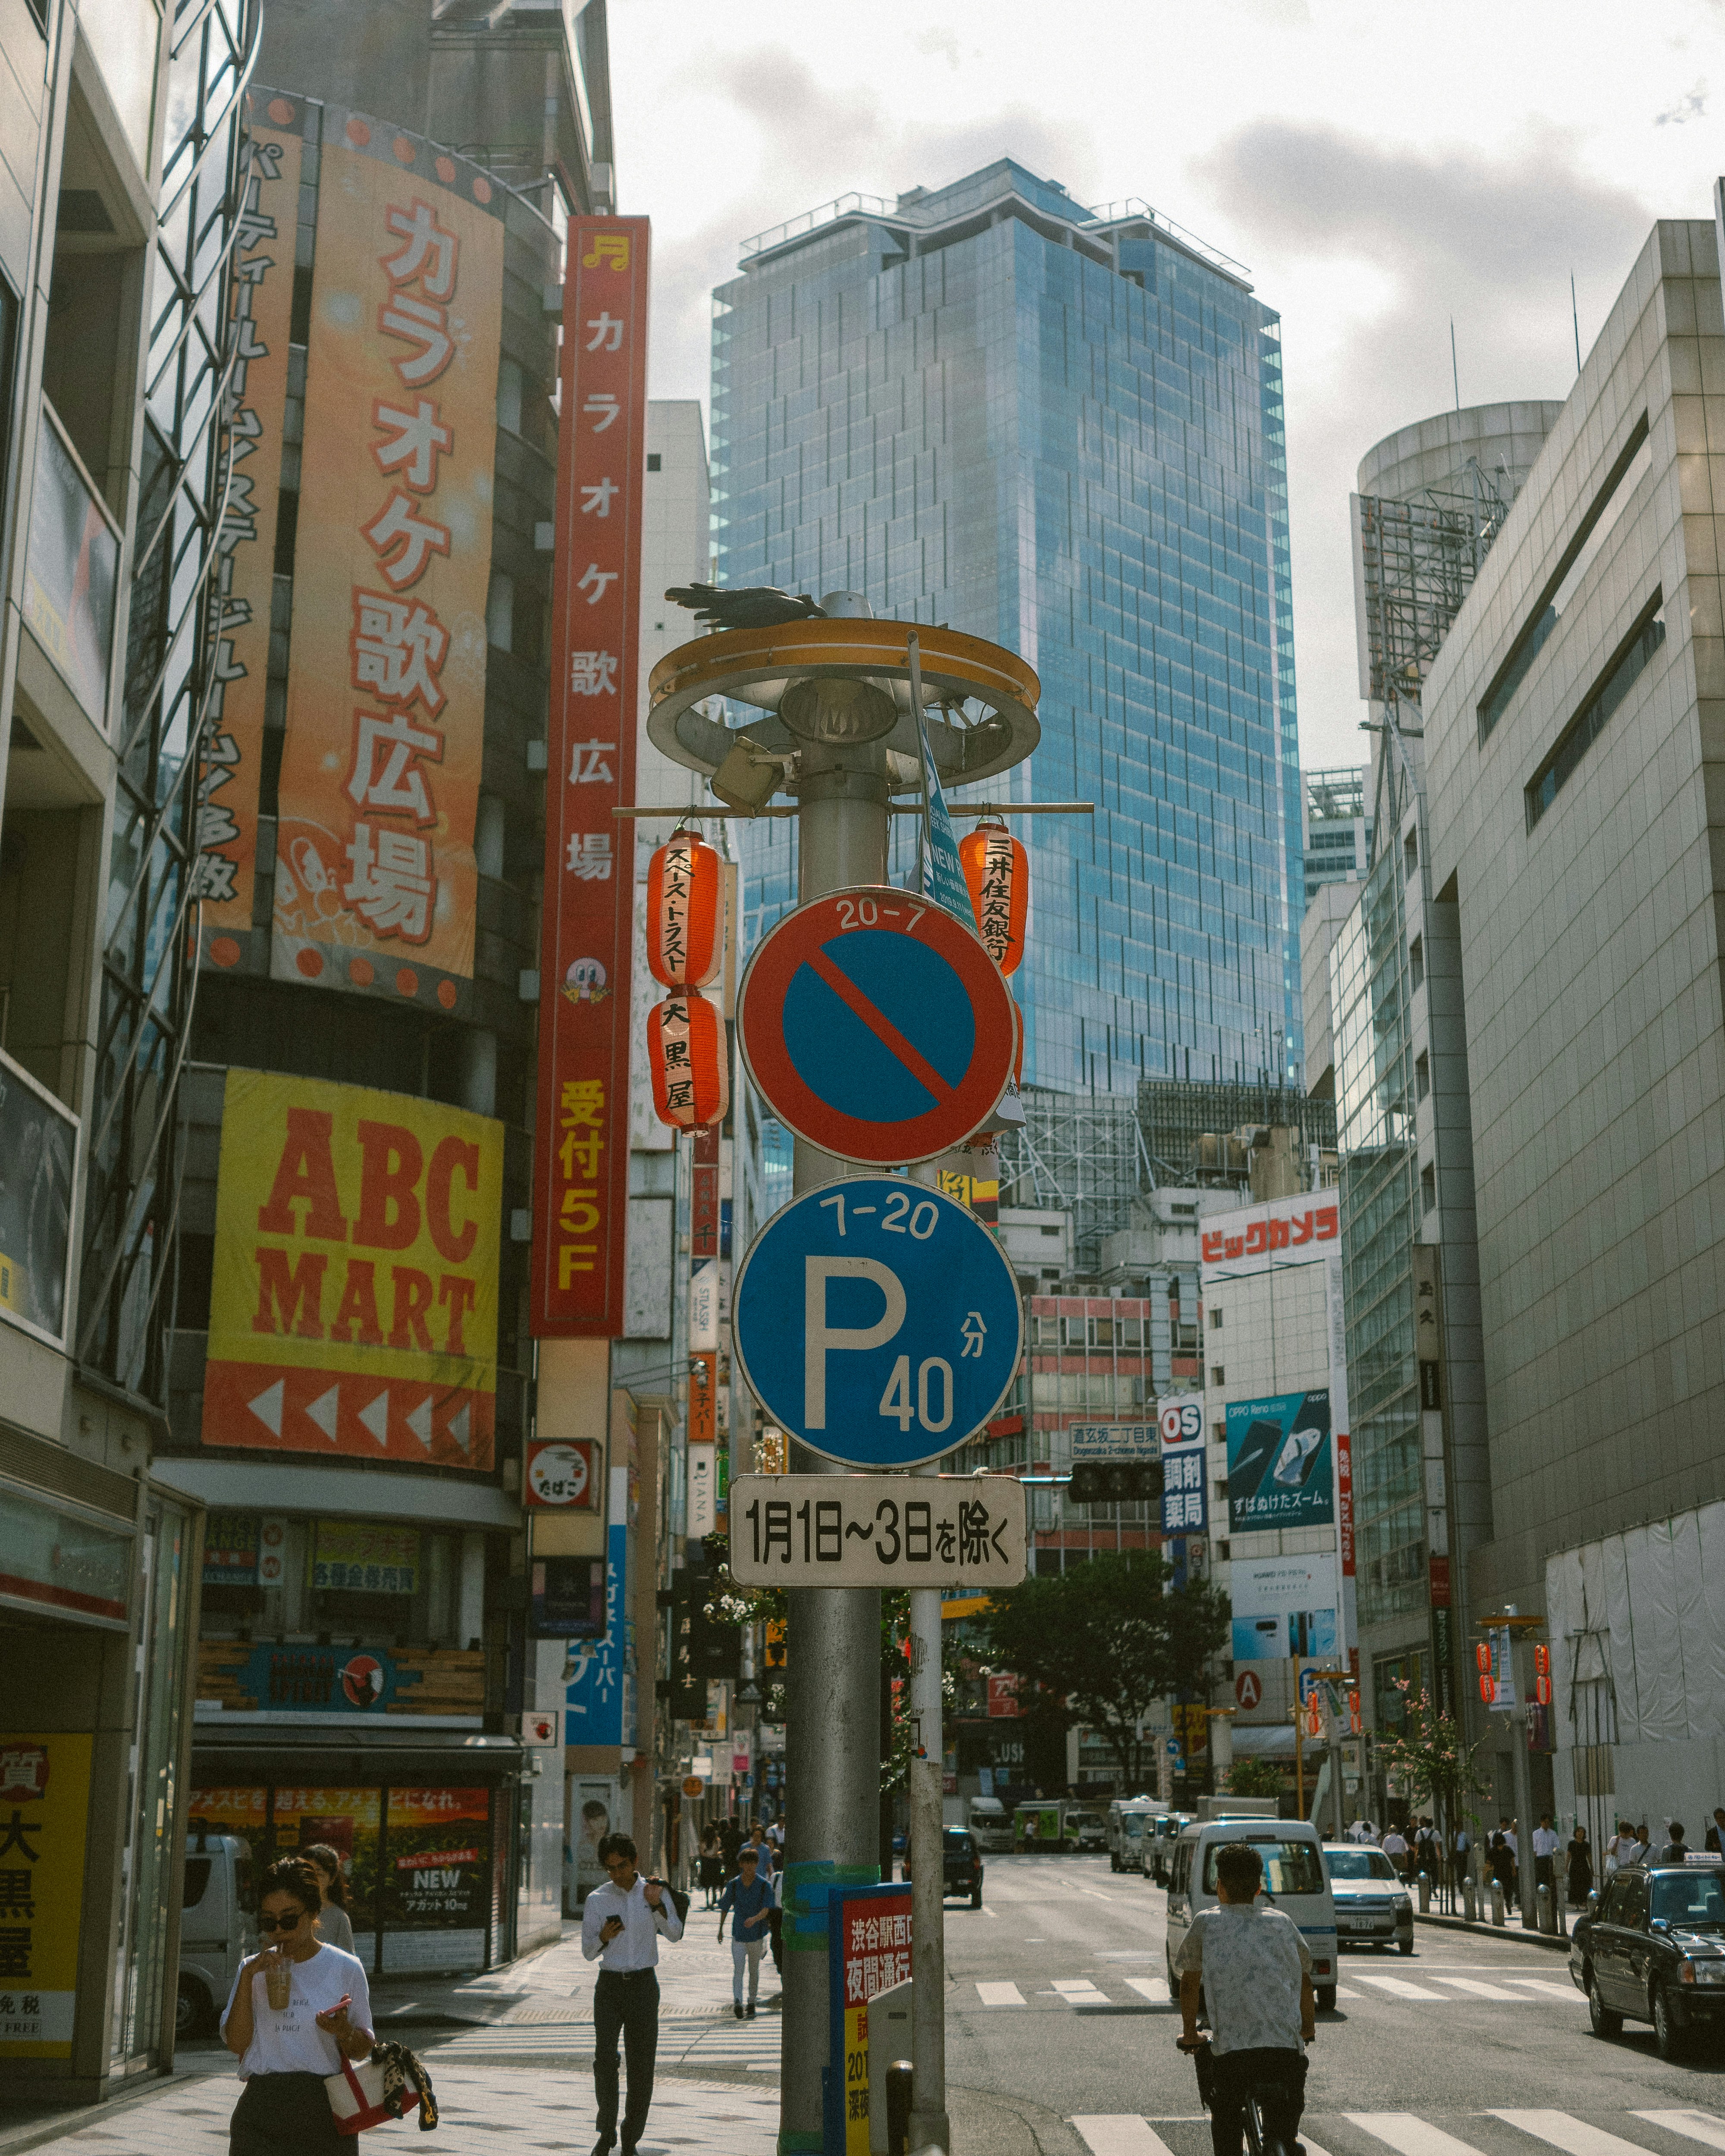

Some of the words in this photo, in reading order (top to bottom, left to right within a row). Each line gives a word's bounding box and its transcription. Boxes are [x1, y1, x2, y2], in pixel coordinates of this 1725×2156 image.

[345, 197, 458, 943] カラオケ歌広場
[566, 310, 624, 882] カラオケ歌広場
[931, 843, 955, 874] NEW
[662, 848, 695, 972] スペース・トラスト
[836, 896, 926, 932] 20-7
[978, 839, 1015, 962] 三井住友銀行
[661, 1003, 696, 1111] 大黒屋
[258, 1107, 480, 1263] ABC
[558, 1079, 605, 1291] 受付5F
[820, 1191, 939, 1240] 7-20
[1202, 1206, 1339, 1263] ビックカメラ
[252, 1247, 476, 1357] MART
[805, 1255, 906, 1429] P
[960, 1311, 988, 1358] 分
[879, 1355, 953, 1433] 40
[1229, 1405, 1248, 1418] OPPO
[1251, 1404, 1269, 1415] Reno
[1073, 1426, 1157, 1444] 道玄坂二丁目東
[1163, 1405, 1200, 1439] OS
[538, 1481, 576, 1497] たばこ
[1164, 1454, 1201, 1492] 調剤
[1165, 1492, 1203, 1528] 薬局
[0, 1752, 44, 1795] 質
[0, 1811, 42, 1978] 大黒屋
[413, 1869, 461, 1889] NEW
[0, 1994, 40, 2015] 免税
[5, 2021, 40, 2034] FREE
